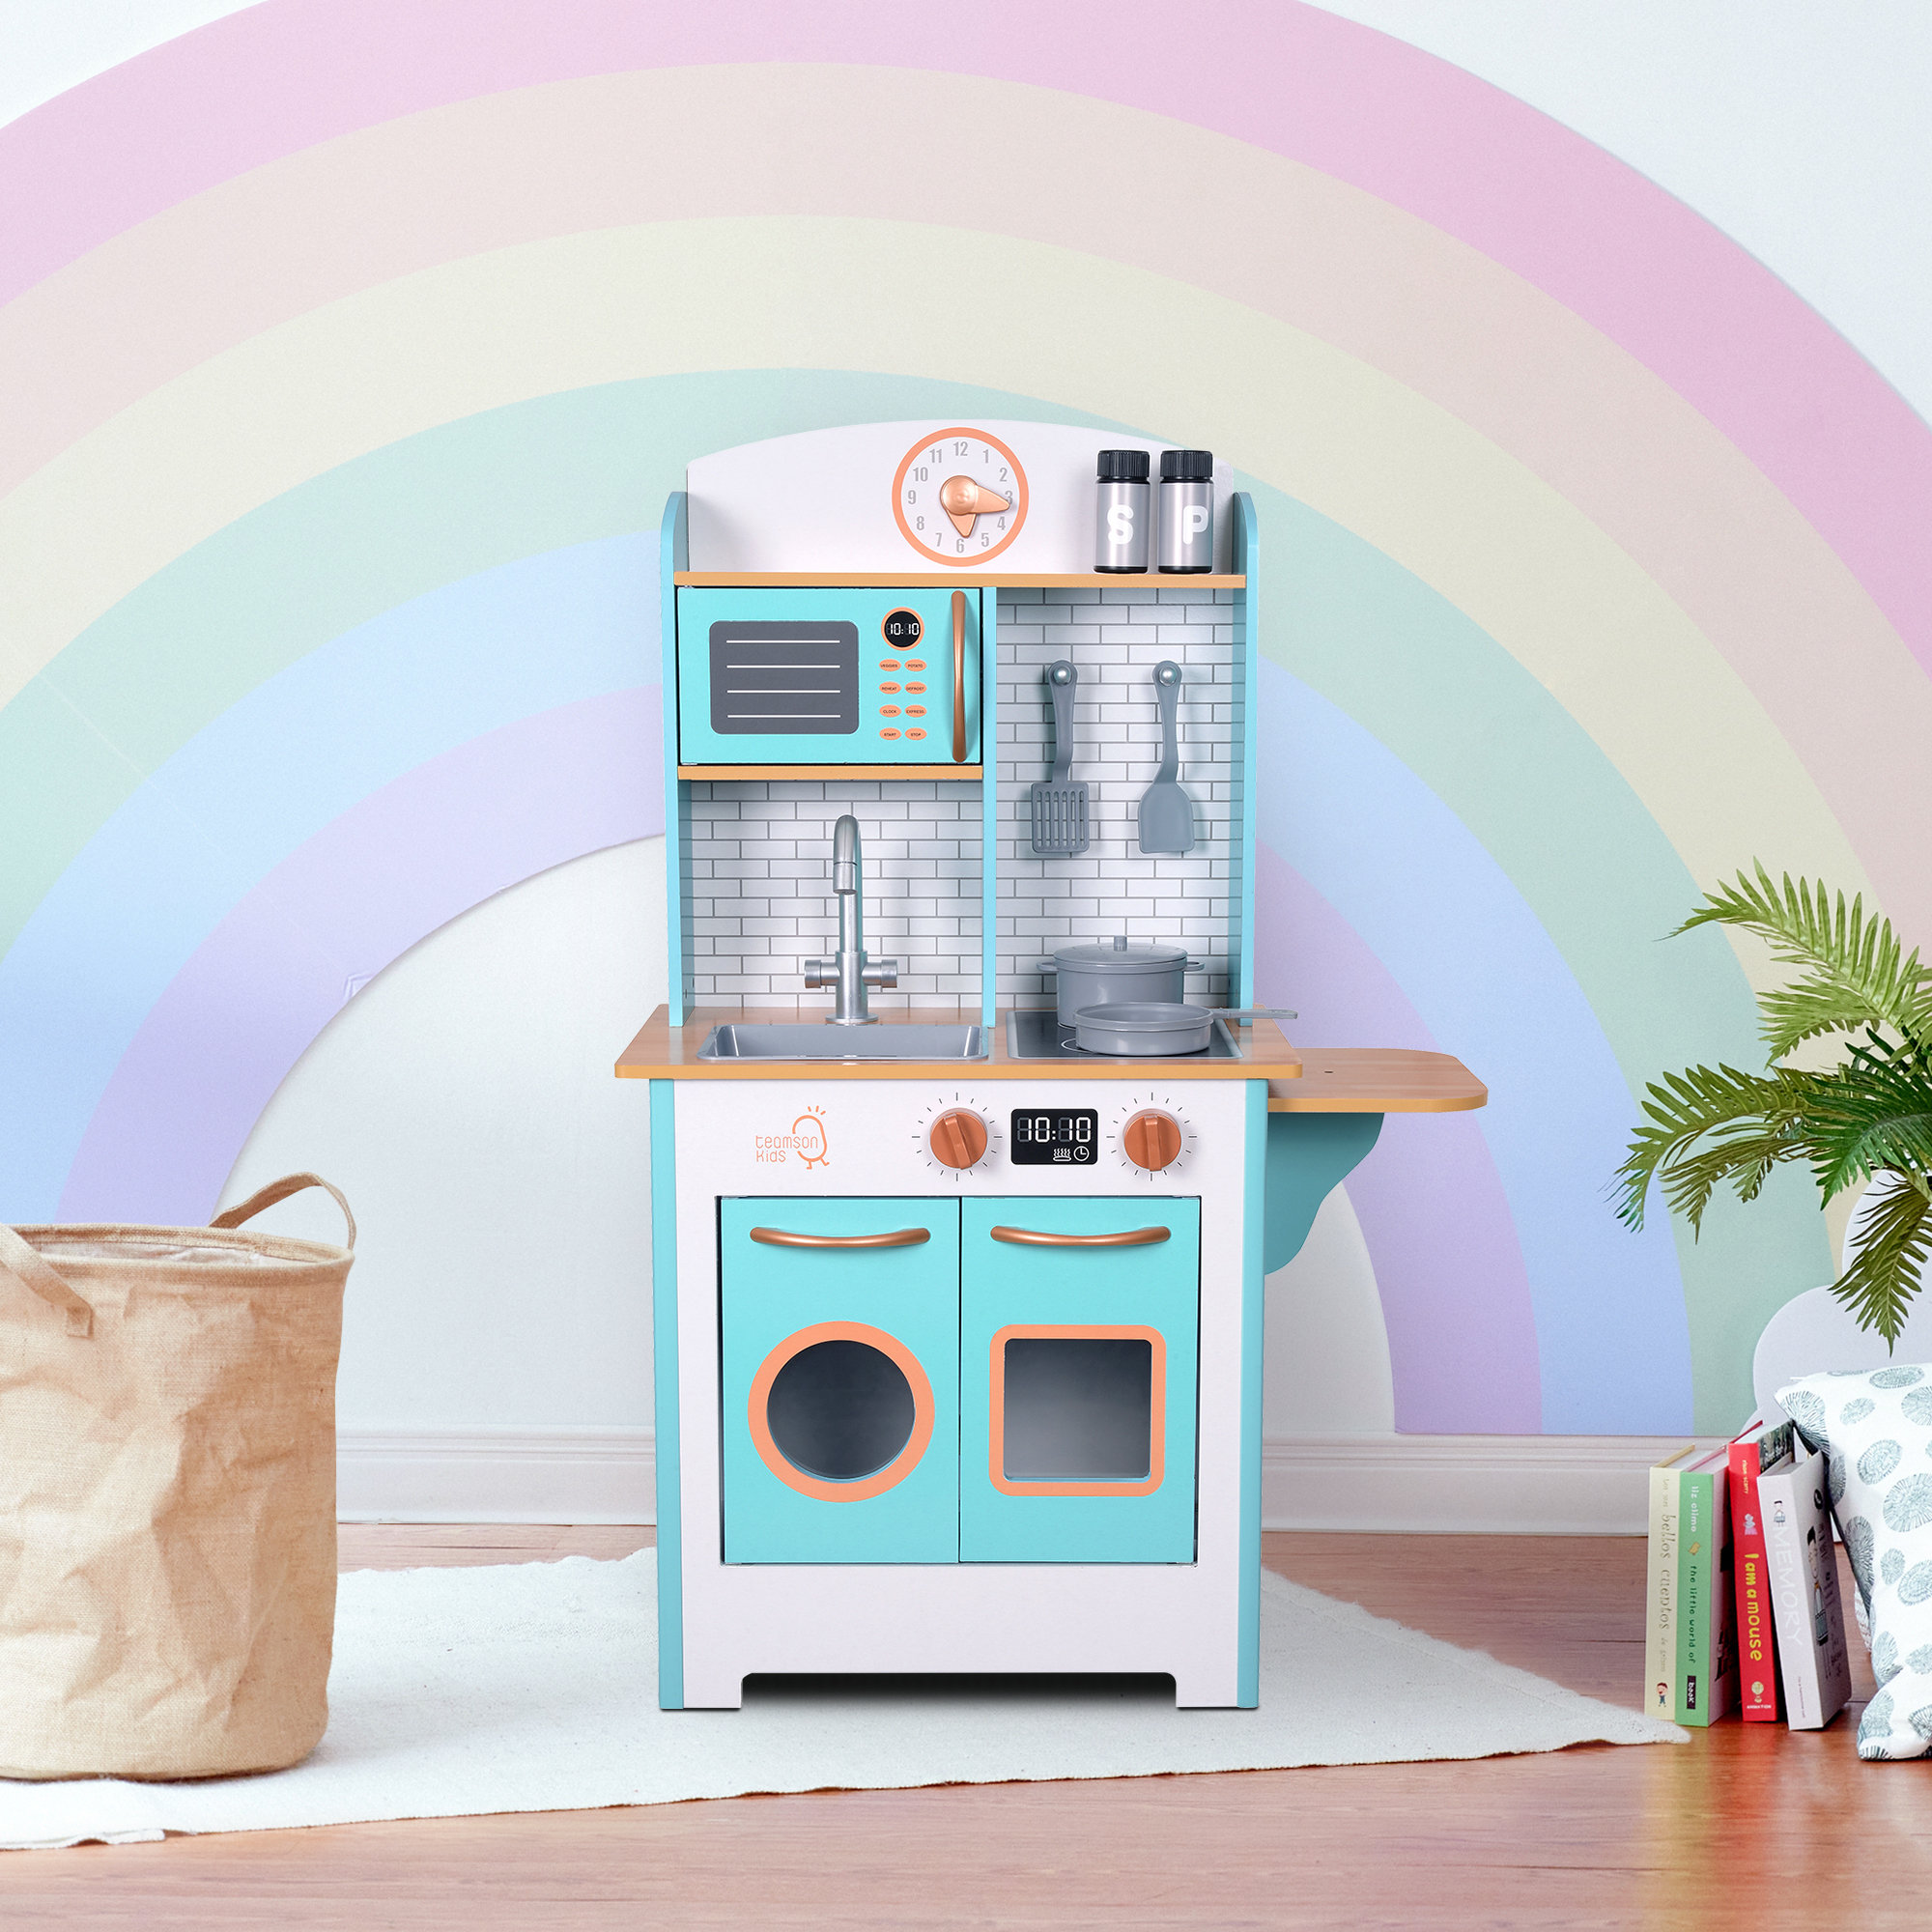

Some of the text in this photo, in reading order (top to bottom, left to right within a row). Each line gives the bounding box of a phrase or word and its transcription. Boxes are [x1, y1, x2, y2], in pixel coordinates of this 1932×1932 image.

[929, 448, 942, 464] 11
[952, 441, 968, 456] 12
[982, 449, 989, 464] 1
[913, 467, 928, 482] 10
[999, 468, 1008, 482] 2
[907, 490, 917, 504] 9
[1005, 490, 1013, 505] 3
[916, 516, 924, 530] 8
[997, 516, 1006, 530] 4
[1107, 504, 1134, 545] S
[1182, 505, 1208, 545] P
[935, 532, 943, 547] 7
[955, 538, 965, 554] 6
[980, 532, 989, 547] 5
[890, 622, 920, 636] 10:10
[1028, 1117, 1092, 1143] 10:10
[755, 1135, 818, 1149] teamson
[1690, 1486, 1699, 1533] liz climo
[1661, 1514, 1676, 1558] bellos
[1745, 1562, 1756, 1585] am
[1773, 1526, 1804, 1645] MEMORY
[1659, 1569, 1672, 1630] cuentos
[1746, 1589, 1757, 1599] a
[1747, 1601, 1763, 1662] mouse
[1689, 1652, 1696, 1663] of
